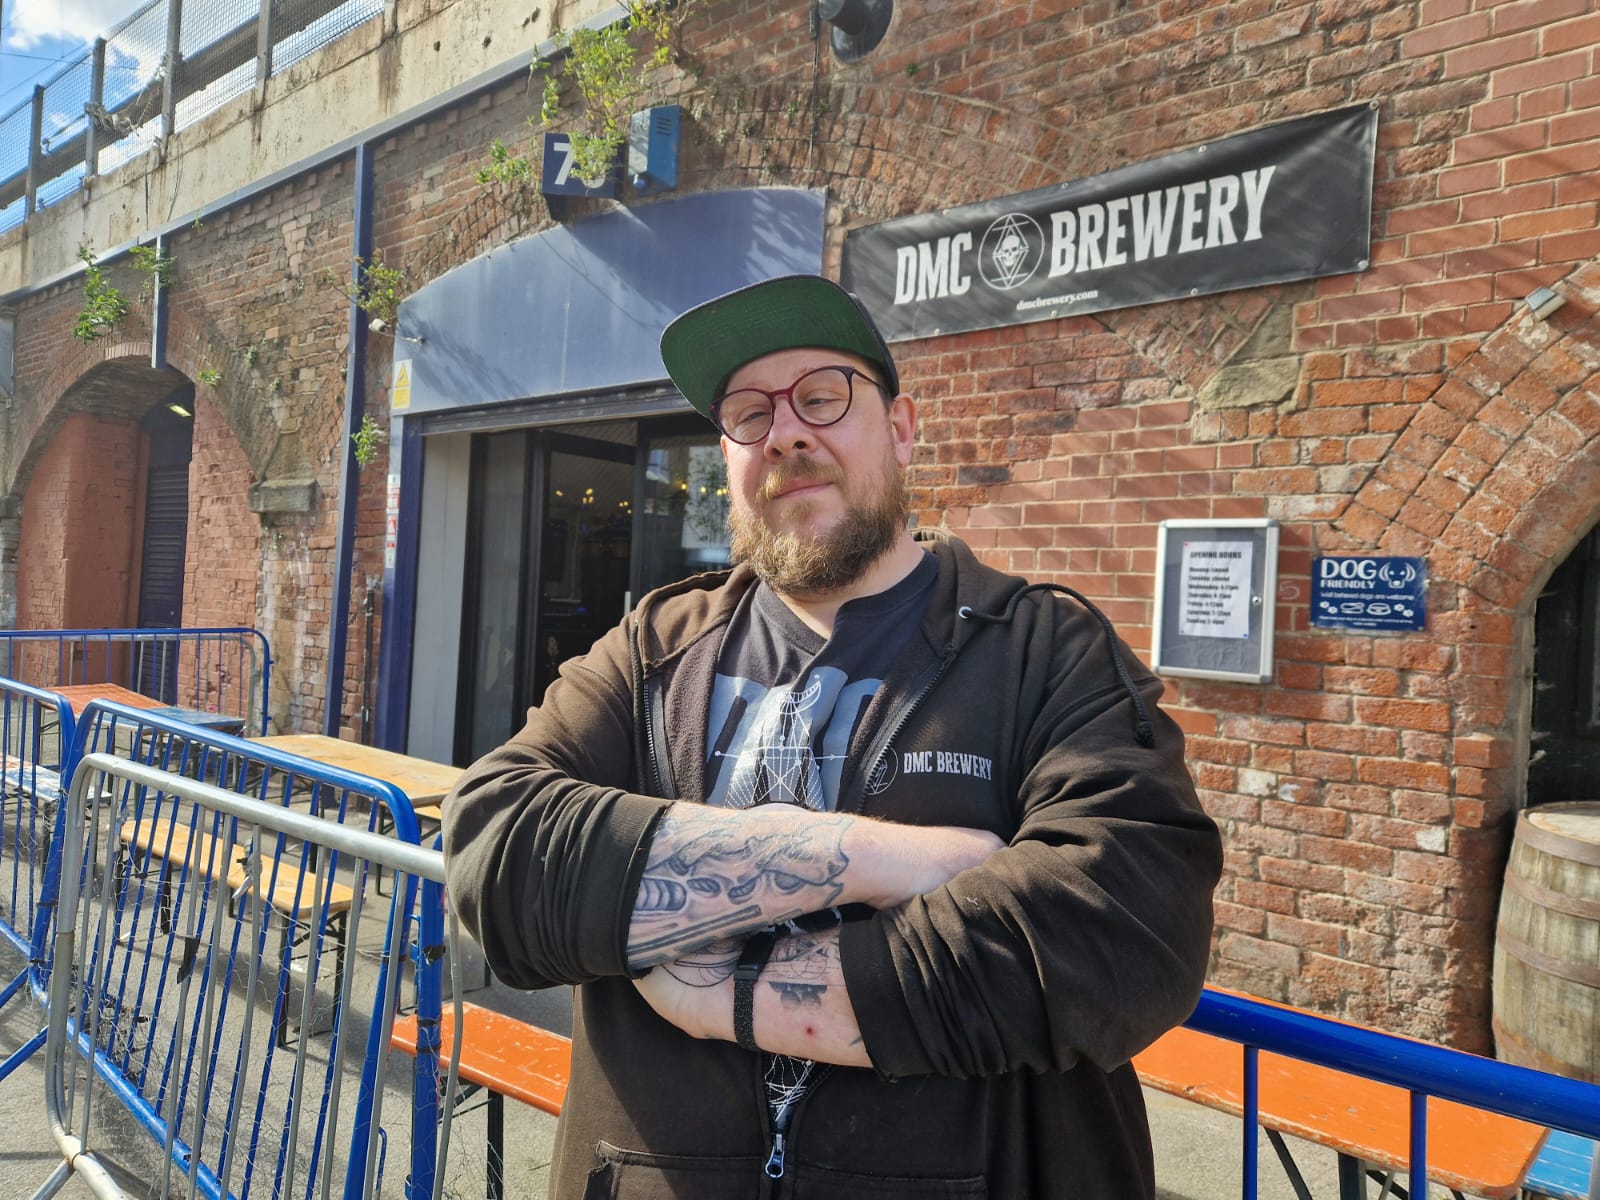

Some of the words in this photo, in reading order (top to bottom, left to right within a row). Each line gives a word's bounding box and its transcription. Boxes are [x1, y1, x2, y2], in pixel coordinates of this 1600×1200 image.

[894, 231, 972, 304] DMC
[1048, 165, 1275, 278] BREWERY
[1016, 290, 1099, 311] dmcbrewery.com
[1218, 551, 1242, 559] HOURS
[1320, 559, 1377, 580] DOG
[1320, 579, 1376, 589] FRIENDLY
[903, 751, 933, 774] DMC
[936, 751, 992, 781] BREWERY
